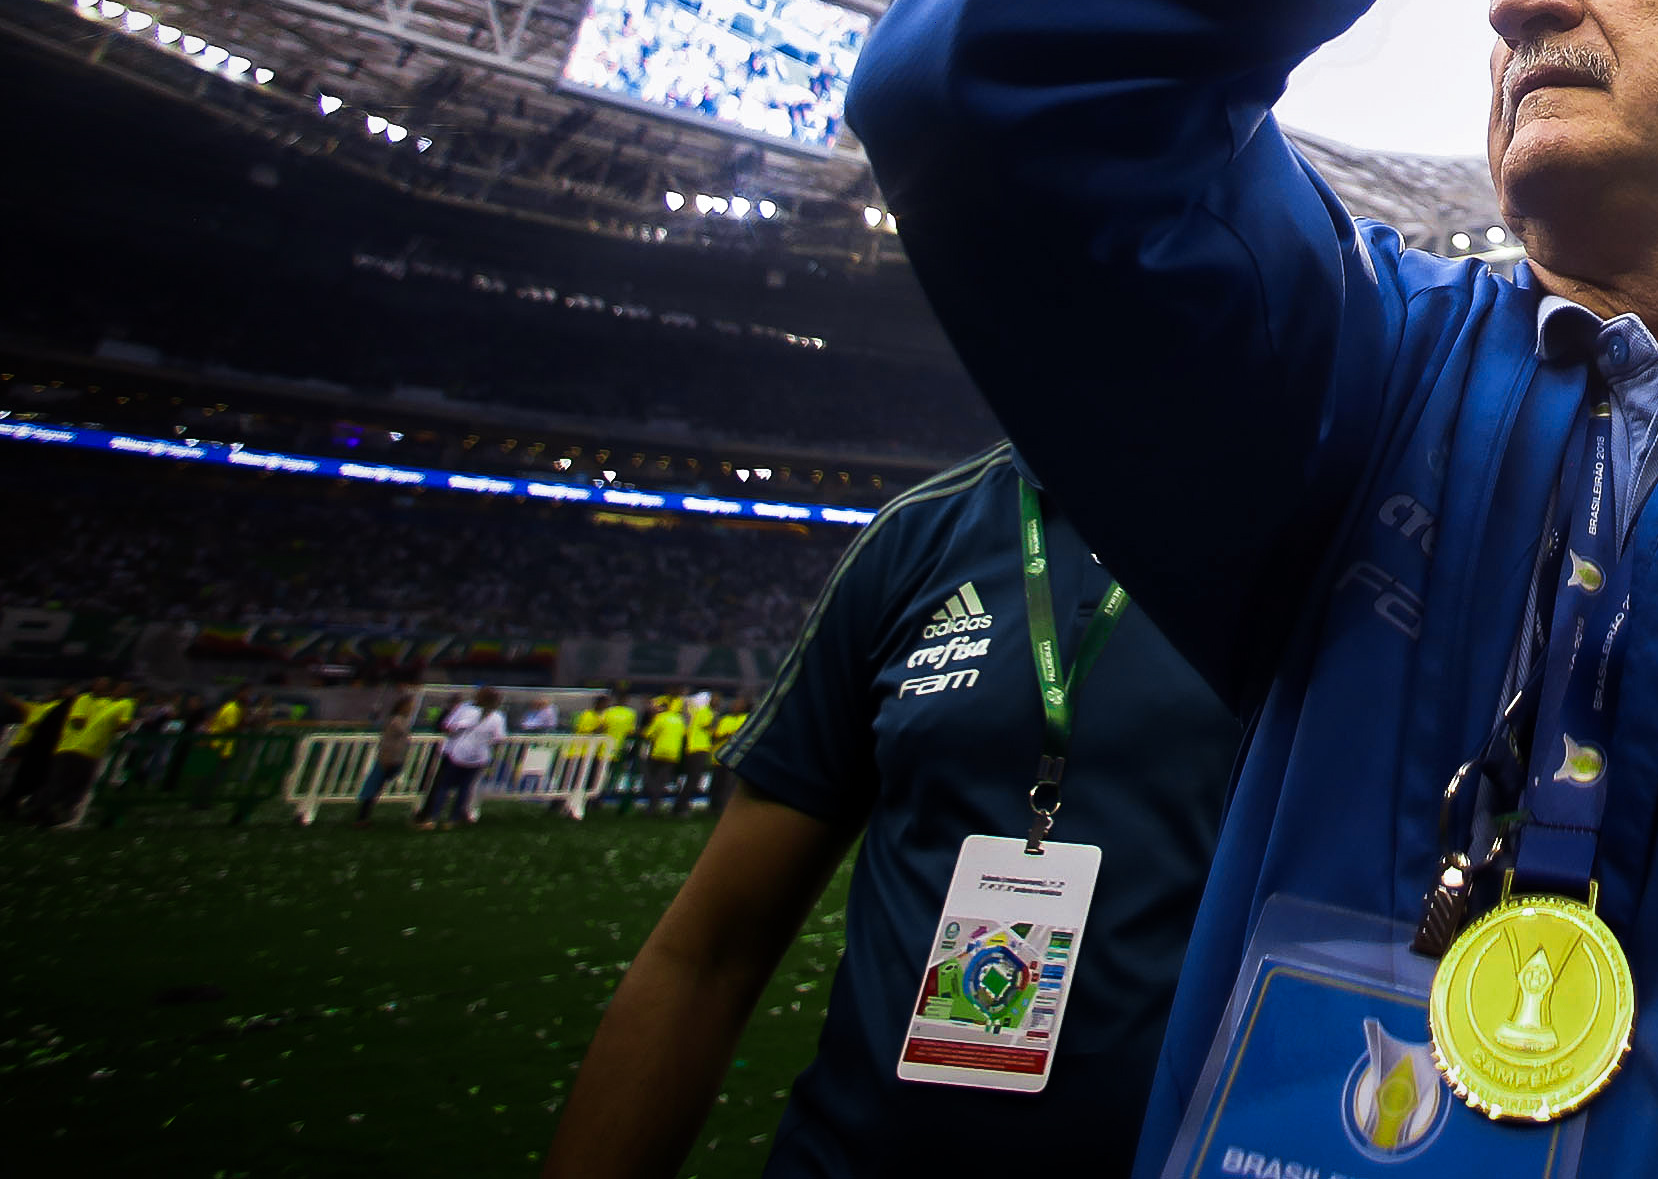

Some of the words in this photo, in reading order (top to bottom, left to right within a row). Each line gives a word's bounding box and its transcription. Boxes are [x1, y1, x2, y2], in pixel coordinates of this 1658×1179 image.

[1588, 462, 1605, 536] BRASILEIRÃO
[923, 614, 993, 639] adidas
[1336, 559, 1425, 643] Fa
[907, 635, 992, 670] crefisa
